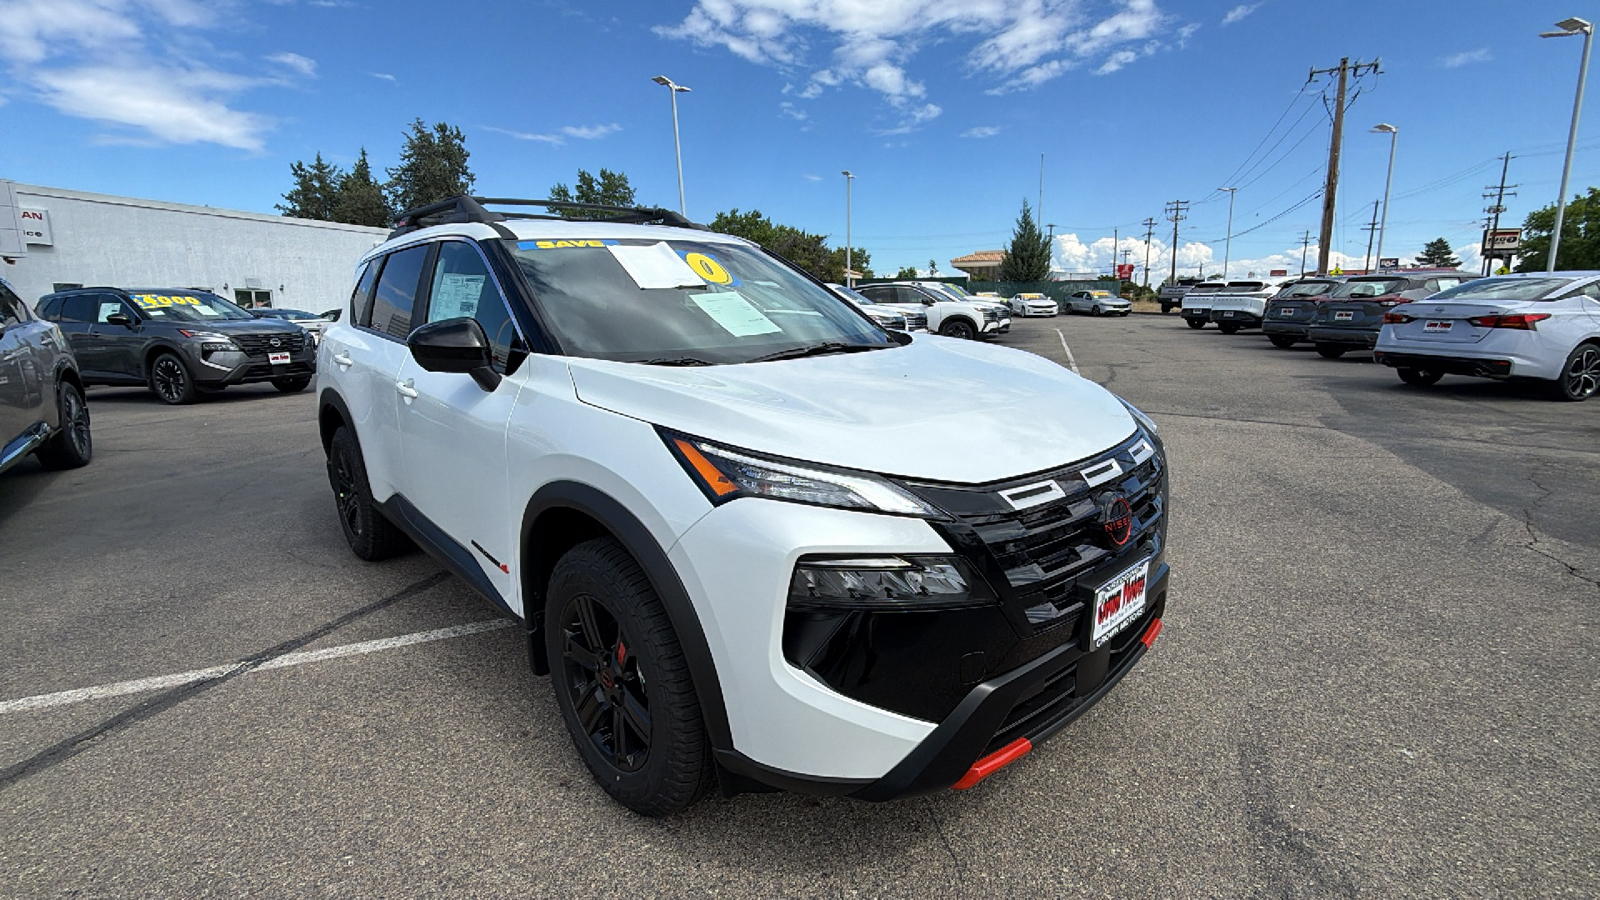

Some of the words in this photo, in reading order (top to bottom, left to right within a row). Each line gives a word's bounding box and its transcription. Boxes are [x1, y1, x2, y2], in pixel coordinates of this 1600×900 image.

[535, 240, 606, 249] SAVE
[1096, 623, 1120, 647] CROWN
[1120, 607, 1145, 631] MOTORS
